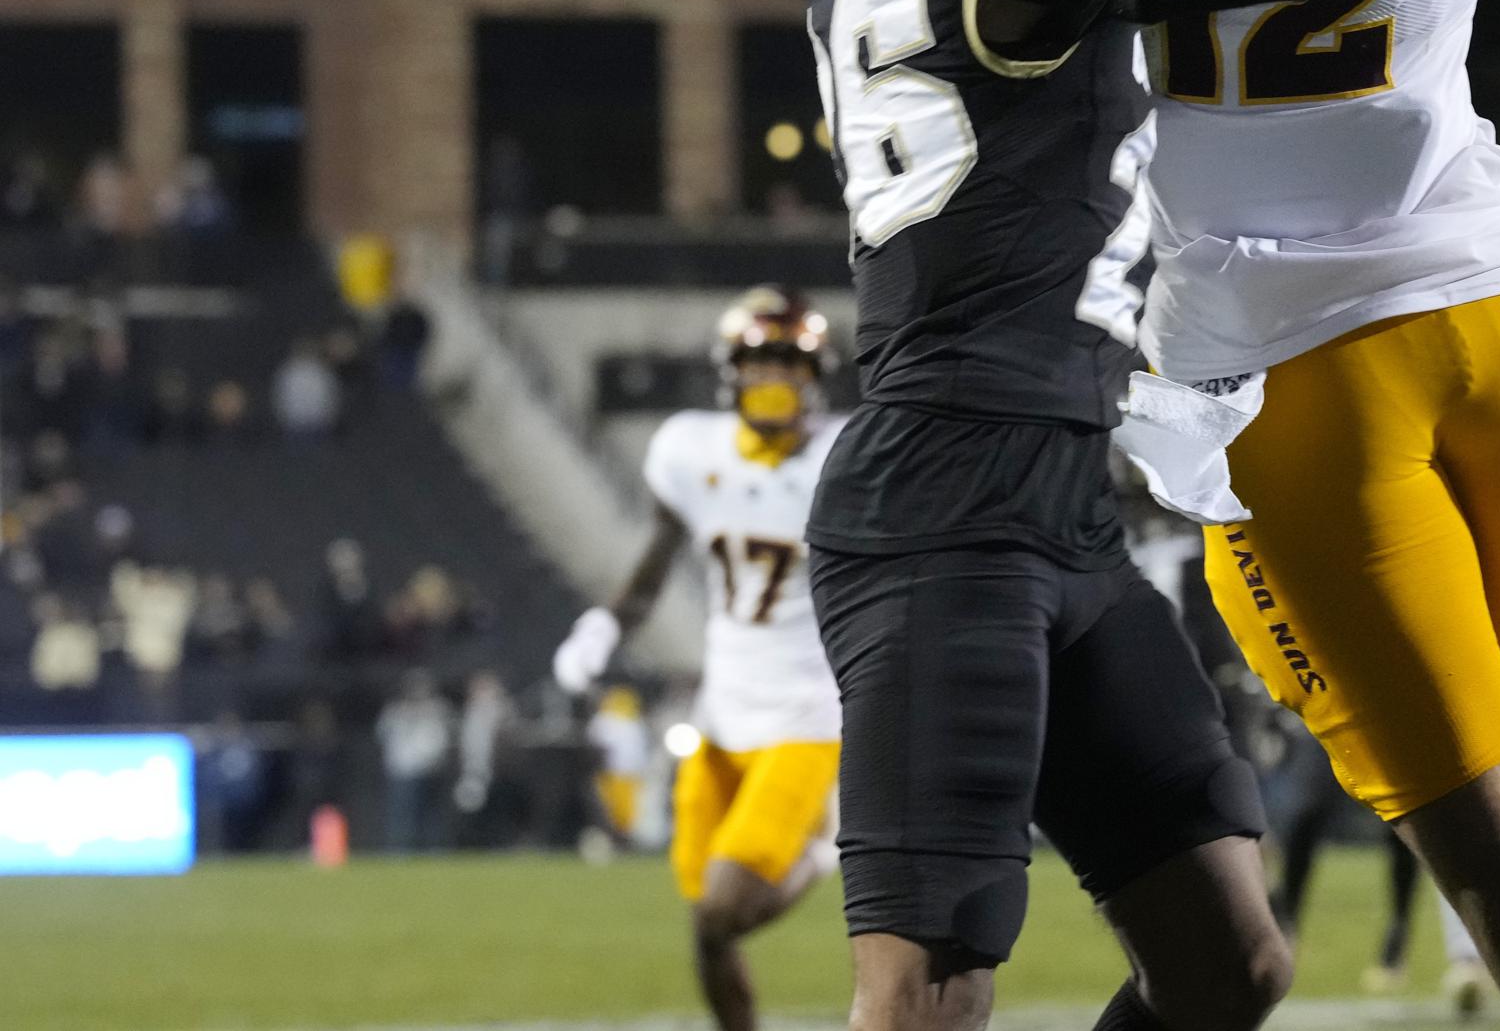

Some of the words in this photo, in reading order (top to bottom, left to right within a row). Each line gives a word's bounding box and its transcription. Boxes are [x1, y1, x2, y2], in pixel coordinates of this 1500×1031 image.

[709, 533, 800, 624] 17
[1224, 523, 1276, 612] DEVI
[1268, 622, 1328, 694] SUN
